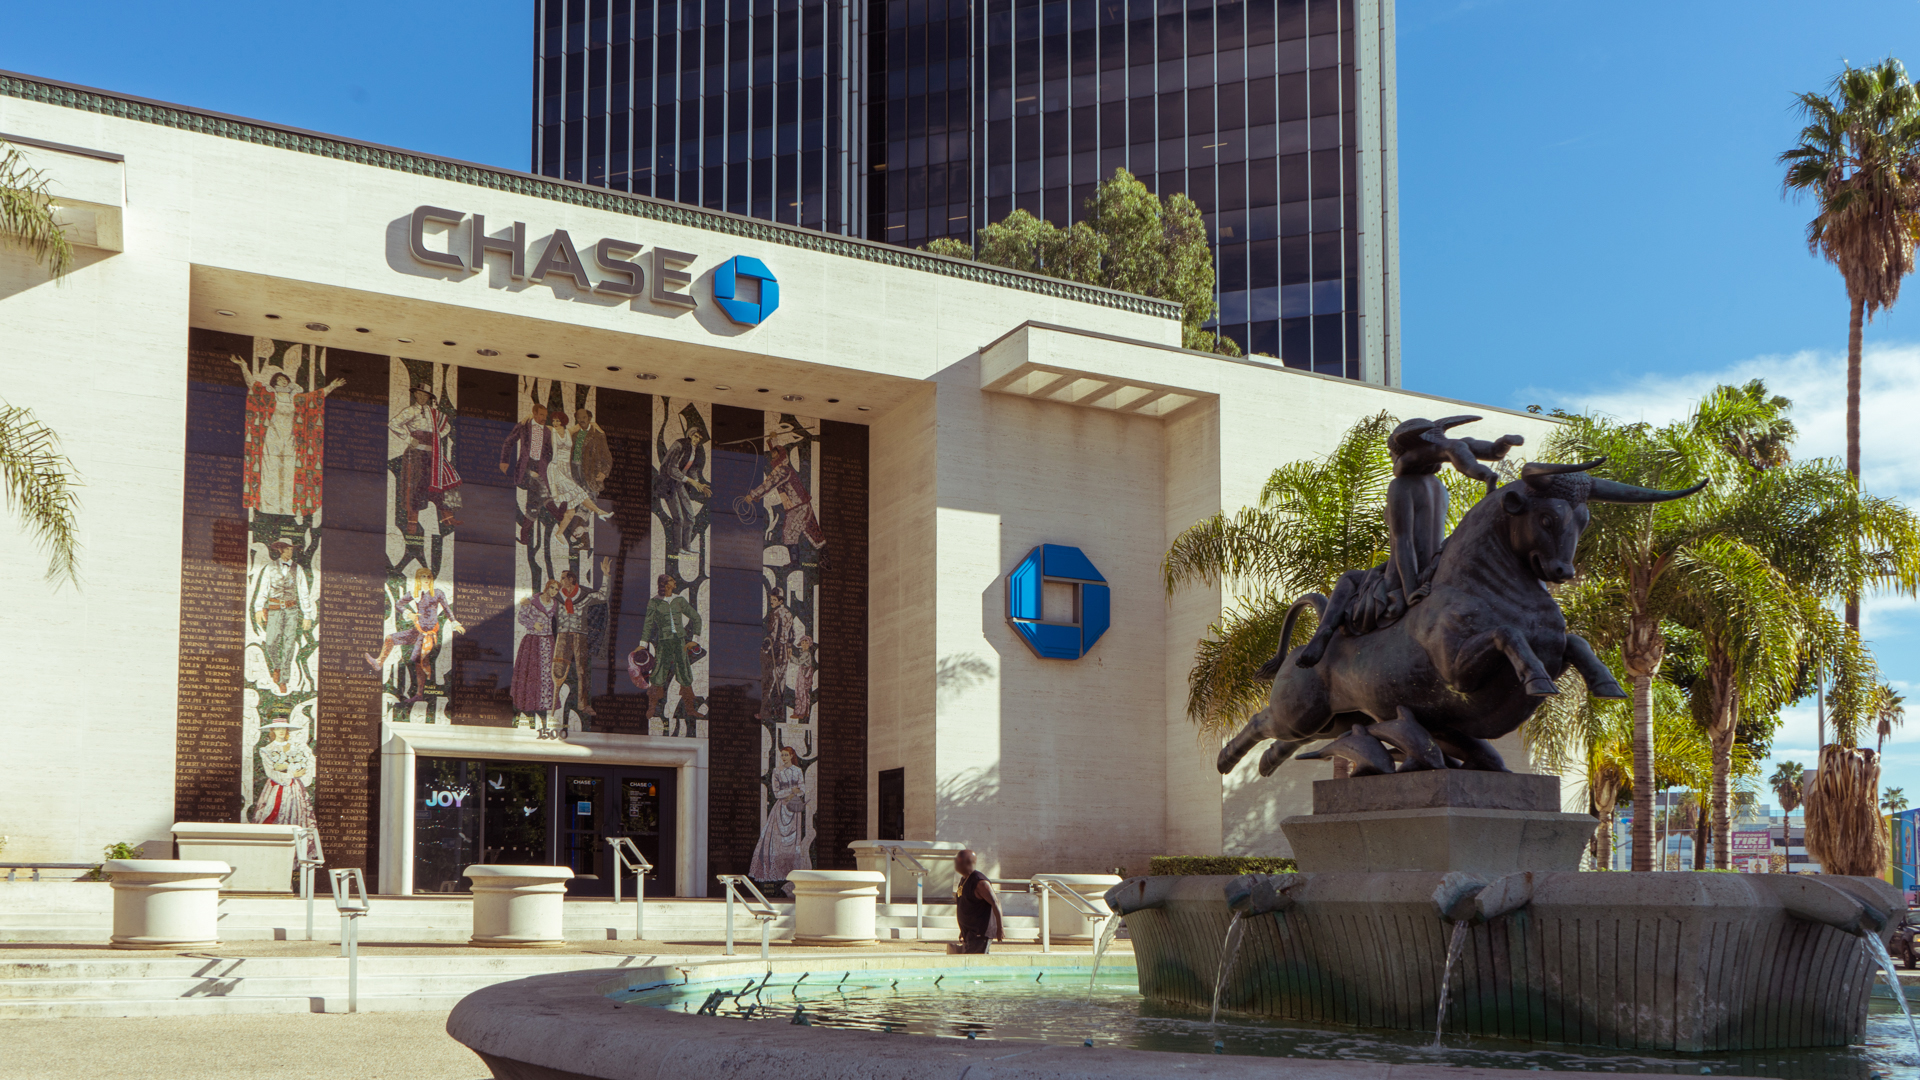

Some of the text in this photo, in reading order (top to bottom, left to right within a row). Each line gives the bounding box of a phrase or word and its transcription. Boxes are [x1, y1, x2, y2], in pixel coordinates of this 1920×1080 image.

[409, 204, 699, 310] CHASE
[536, 728, 568, 740] 1500
[426, 790, 468, 808] JOY
